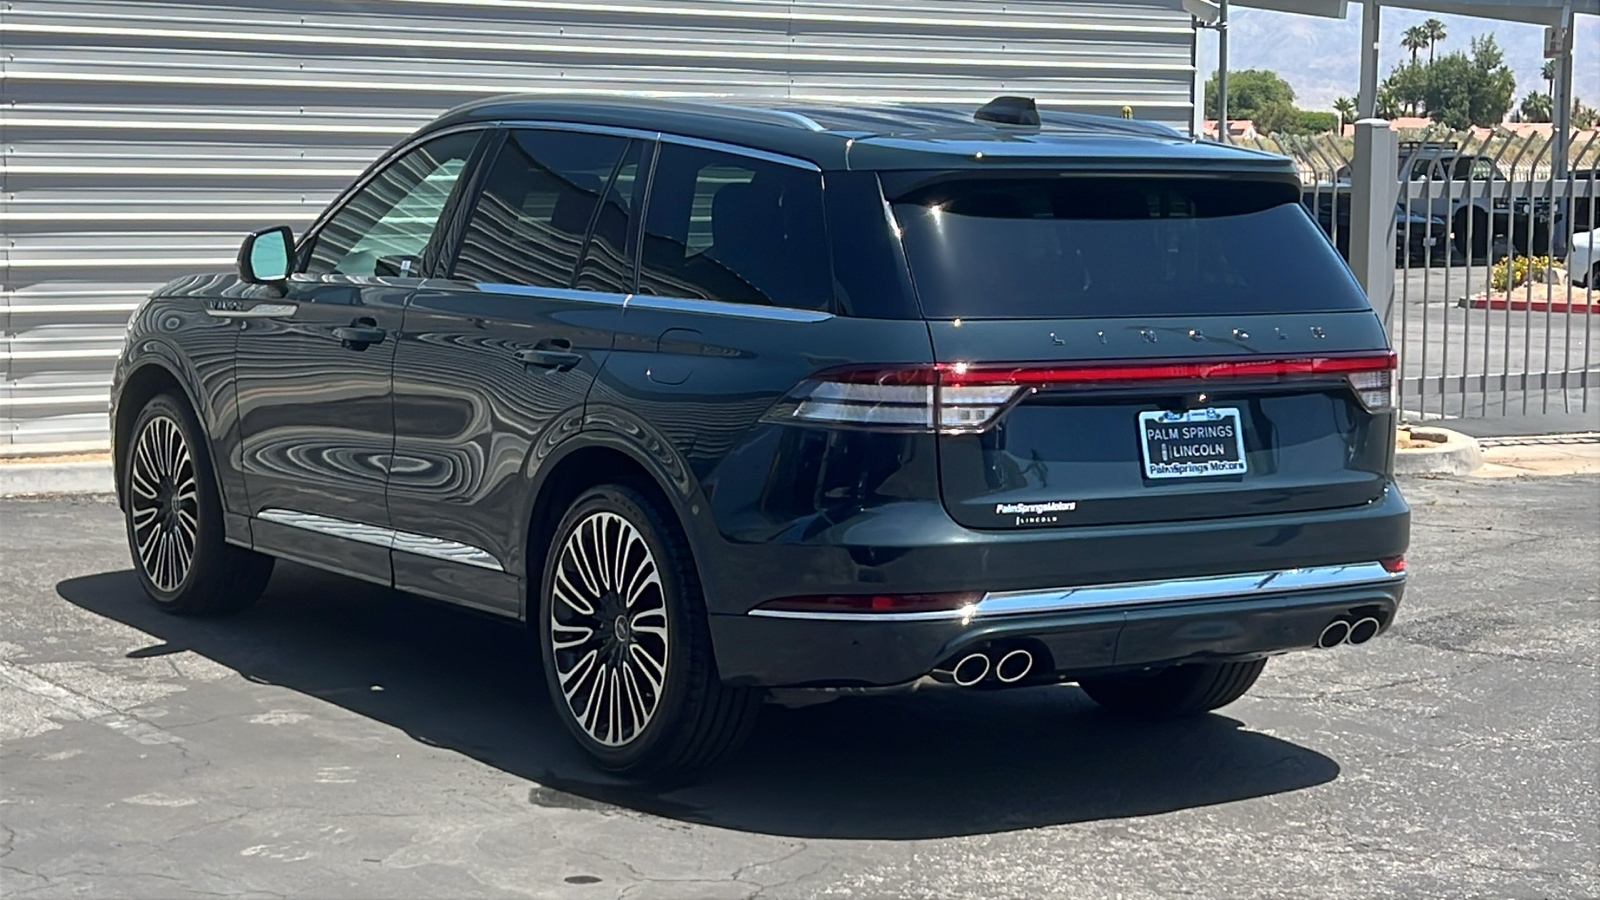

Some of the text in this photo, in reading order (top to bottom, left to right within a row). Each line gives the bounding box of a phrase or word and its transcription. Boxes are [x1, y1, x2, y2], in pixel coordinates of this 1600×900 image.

[1049, 327, 1326, 346] LINCOLN
[1147, 425, 1234, 440] PALM SPRINGS
[1173, 443, 1225, 457] LINCOLN
